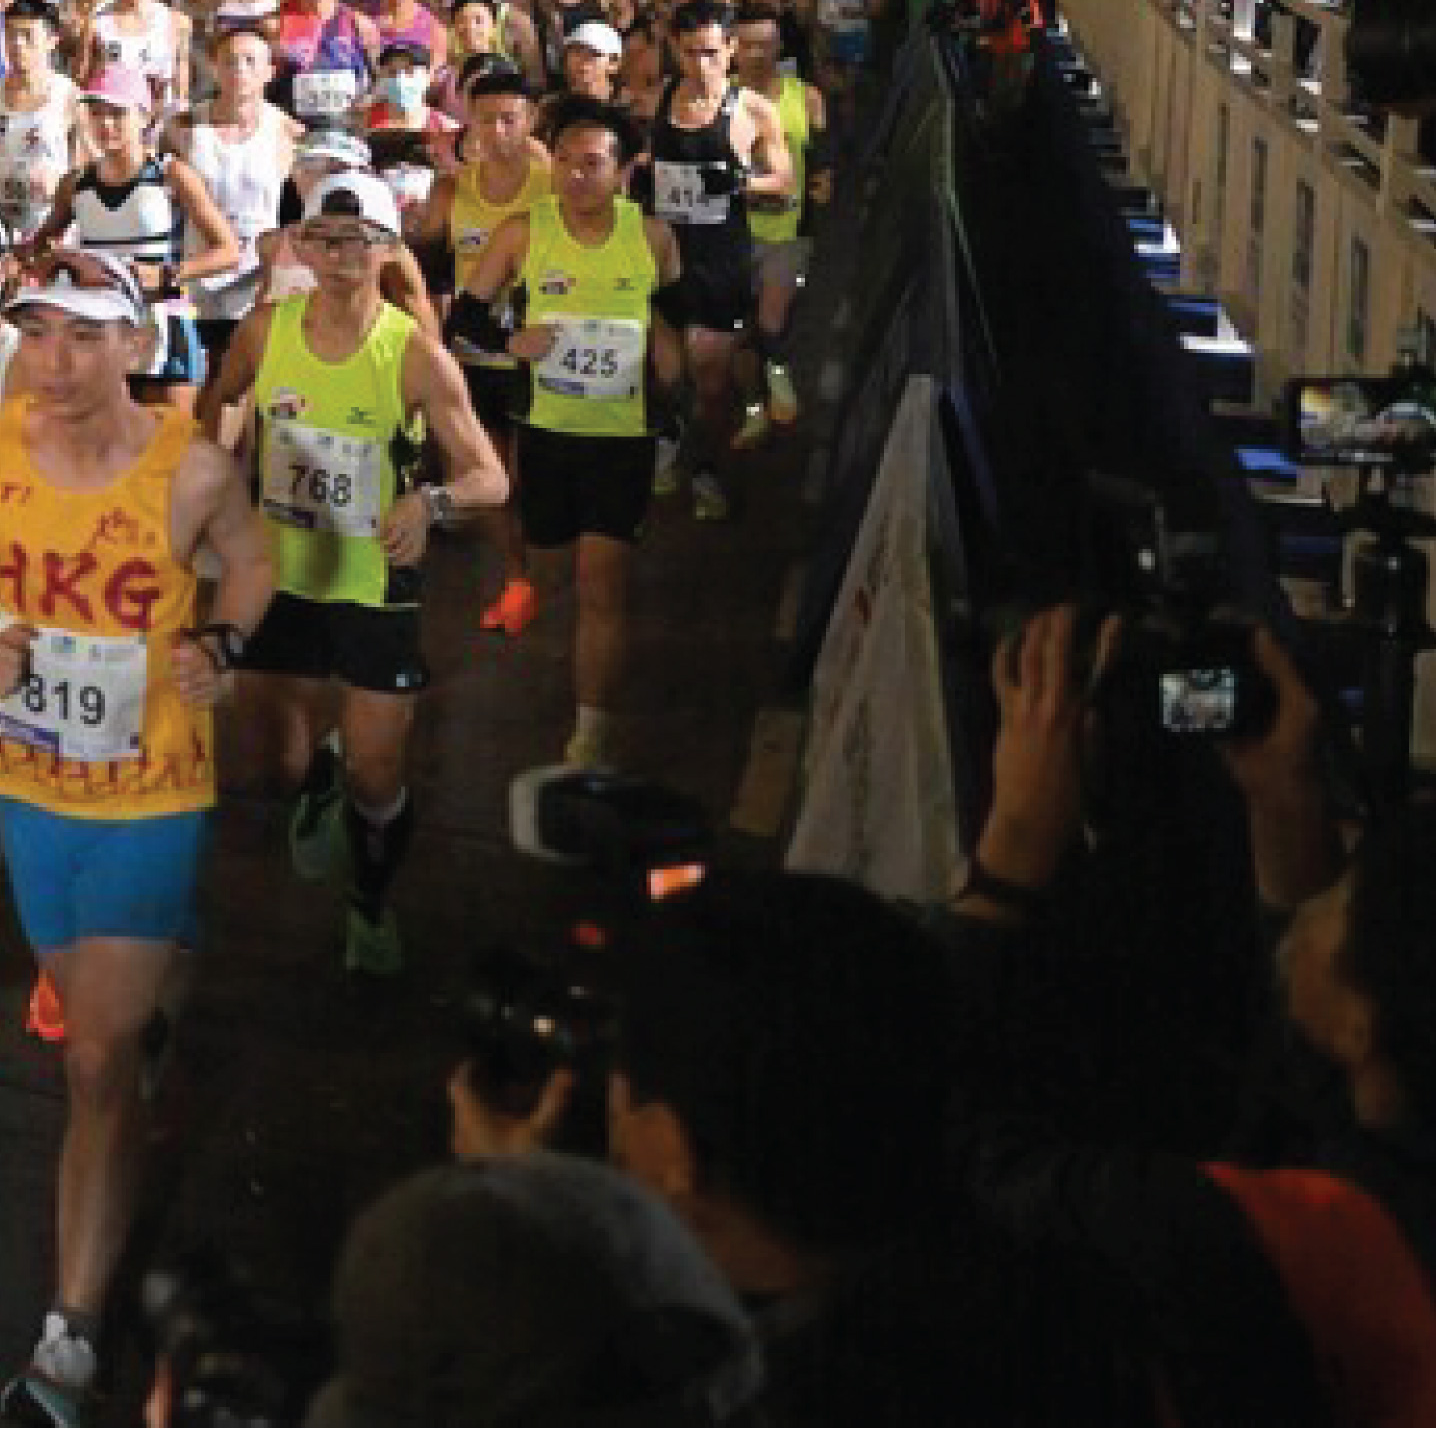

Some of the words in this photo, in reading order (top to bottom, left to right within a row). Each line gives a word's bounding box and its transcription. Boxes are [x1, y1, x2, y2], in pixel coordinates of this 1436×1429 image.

[561, 347, 619, 379] 425
[288, 464, 352, 508] 768
[24, 672, 107, 727] 819
